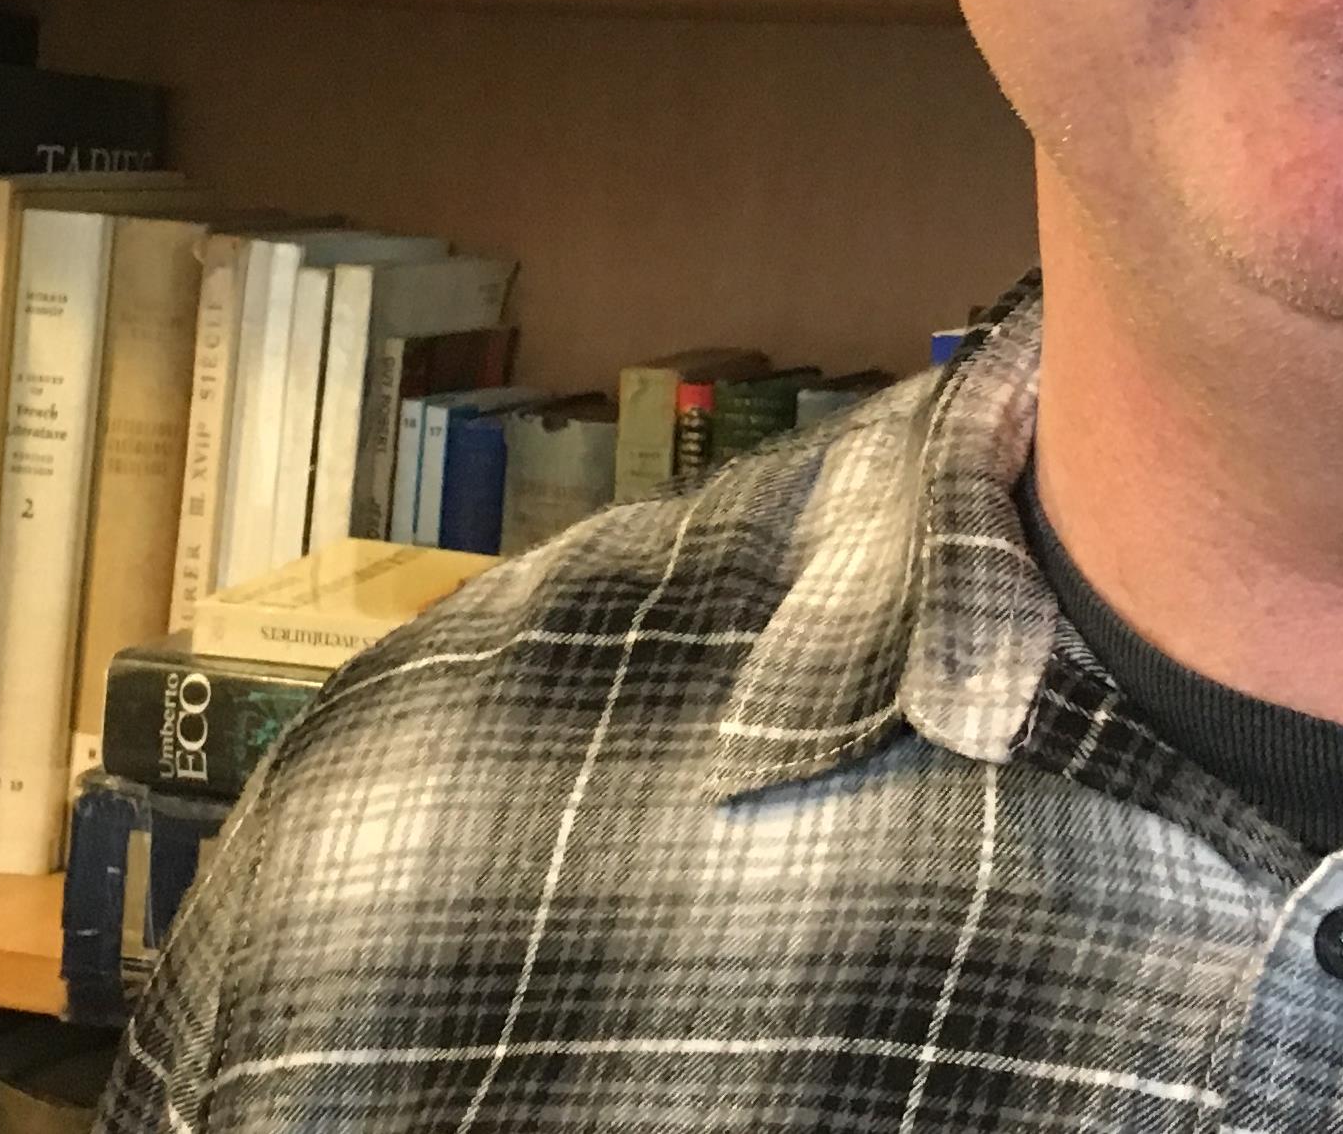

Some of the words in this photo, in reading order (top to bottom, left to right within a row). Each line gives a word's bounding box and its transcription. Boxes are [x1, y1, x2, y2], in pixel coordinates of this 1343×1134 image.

[21, 497, 35, 519] 2
[158, 672, 180, 779] Umberto
[174, 672, 212, 783] ECO
